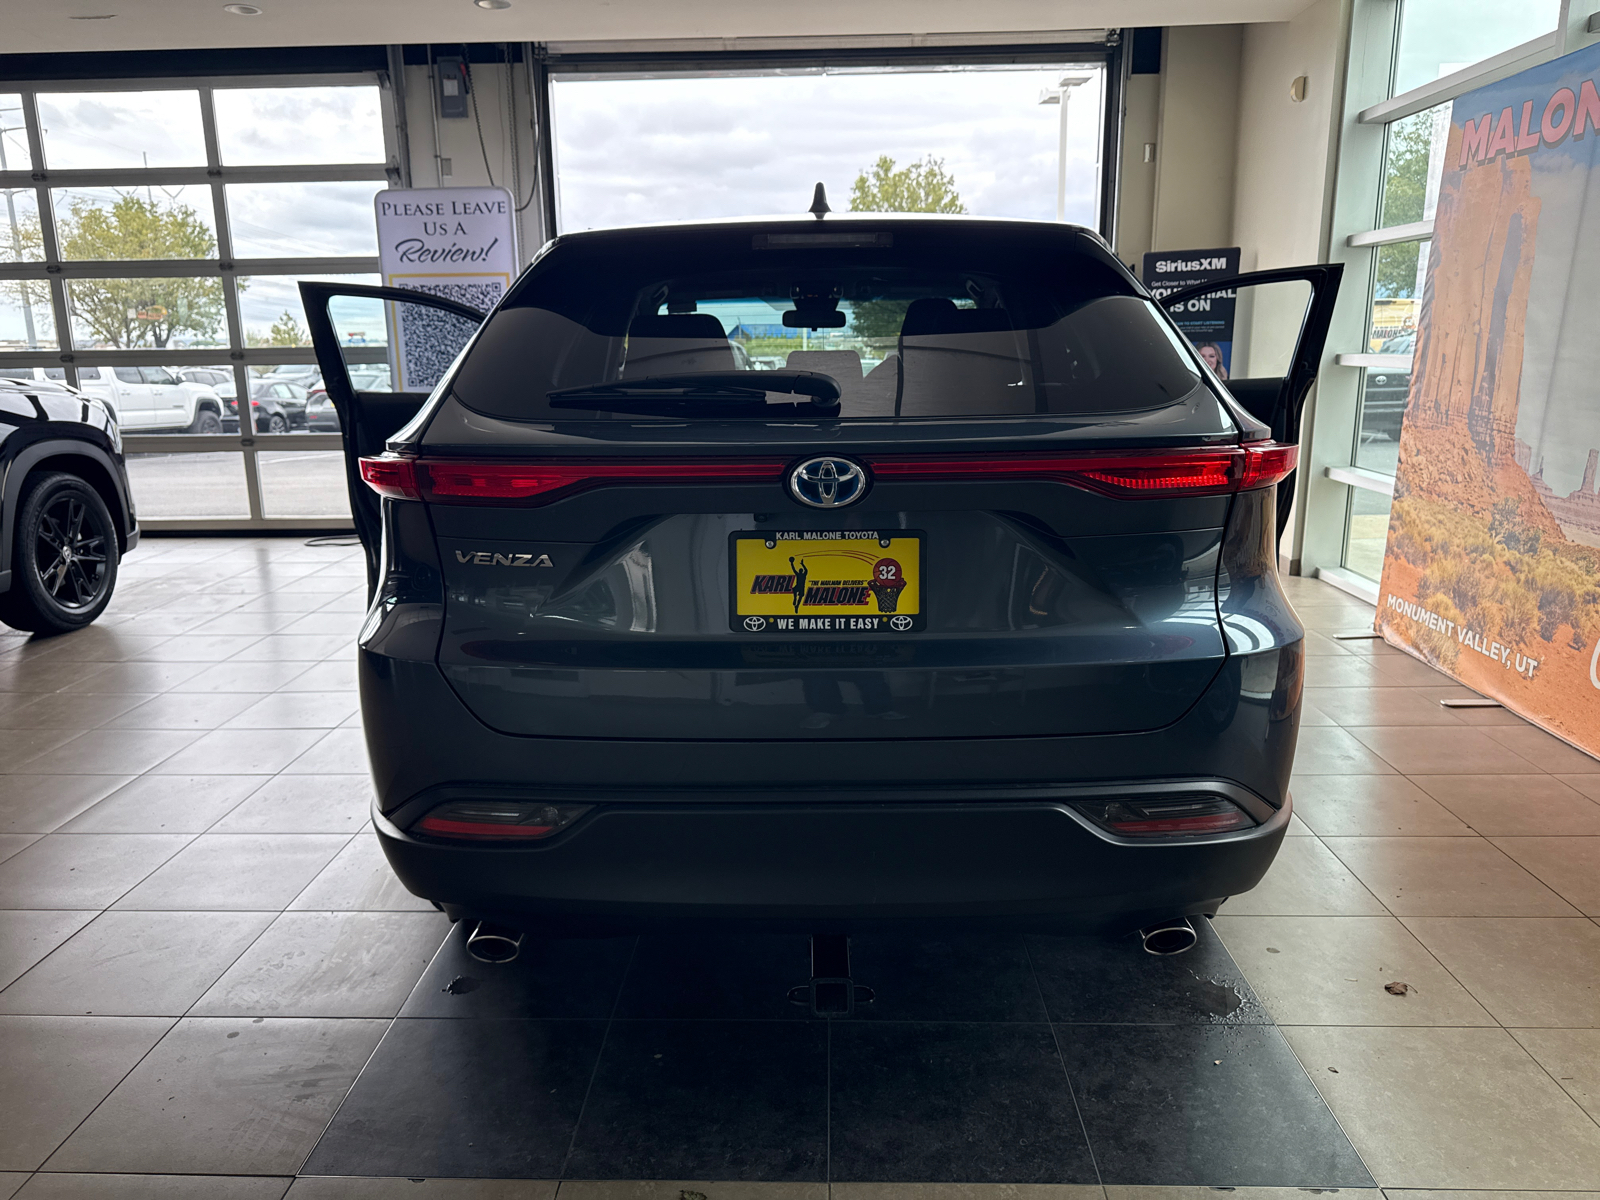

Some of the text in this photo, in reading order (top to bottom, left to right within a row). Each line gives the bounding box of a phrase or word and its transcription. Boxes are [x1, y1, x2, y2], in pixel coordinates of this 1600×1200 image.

[381, 201, 506, 216] PLEASE LEAVE
[423, 222, 467, 236] US A
[395, 237, 499, 264] Review!
[1155, 258, 1227, 272] SiriusXM
[1148, 287, 1183, 300] YO
[1187, 299, 1211, 312] ON
[776, 531, 879, 540] KARL MALONE TOYOTA
[455, 550, 554, 567] VENZA
[879, 565, 896, 580] 32
[750, 574, 796, 594] KARL
[803, 587, 871, 606] MALONE
[777, 618, 879, 630] WE MAKE IT EASY
[1387, 594, 1538, 677] MONUMENT VALLEY, UT
